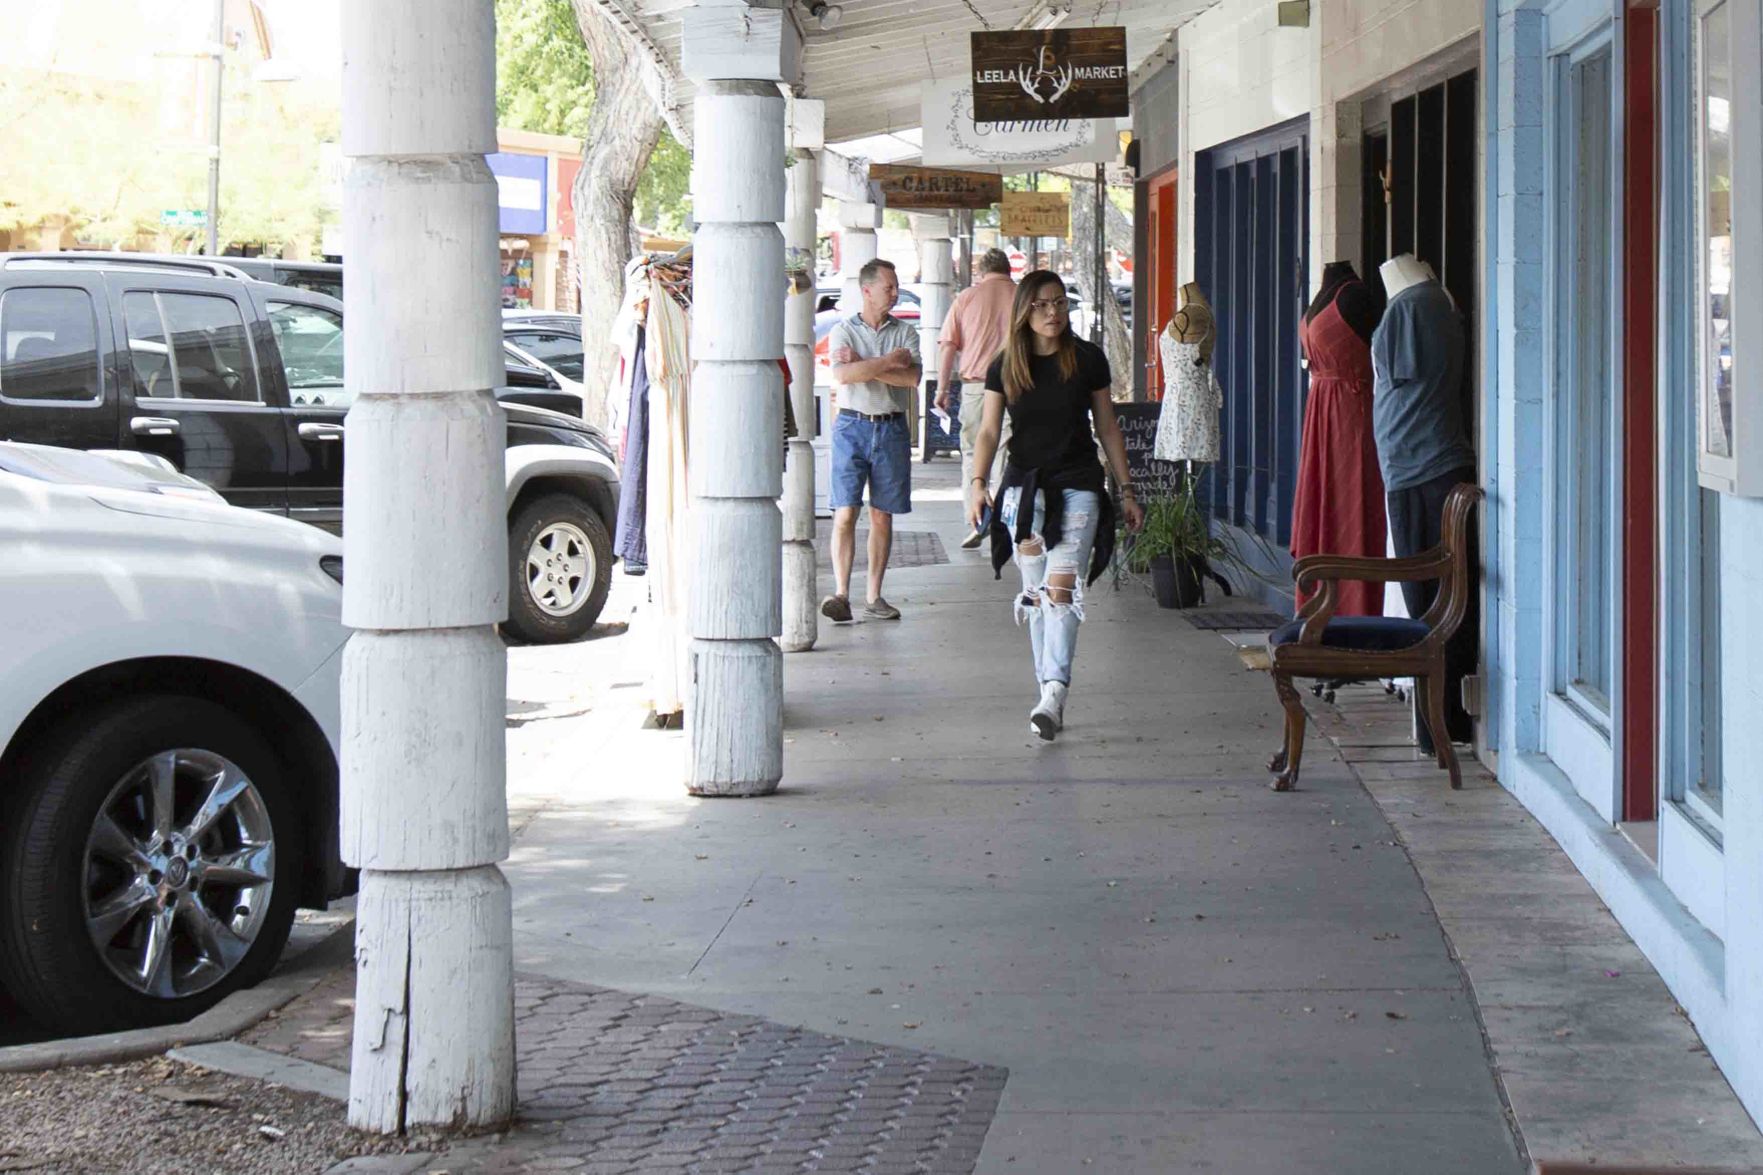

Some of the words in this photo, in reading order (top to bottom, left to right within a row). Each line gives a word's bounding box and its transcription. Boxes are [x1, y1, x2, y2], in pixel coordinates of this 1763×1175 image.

[976, 70, 1018, 84] LEELA
[1074, 65, 1125, 80] MARKET
[902, 176, 976, 193] CARTEL
[1116, 414, 1159, 440] Arizo
[1127, 460, 1180, 489] ocally
